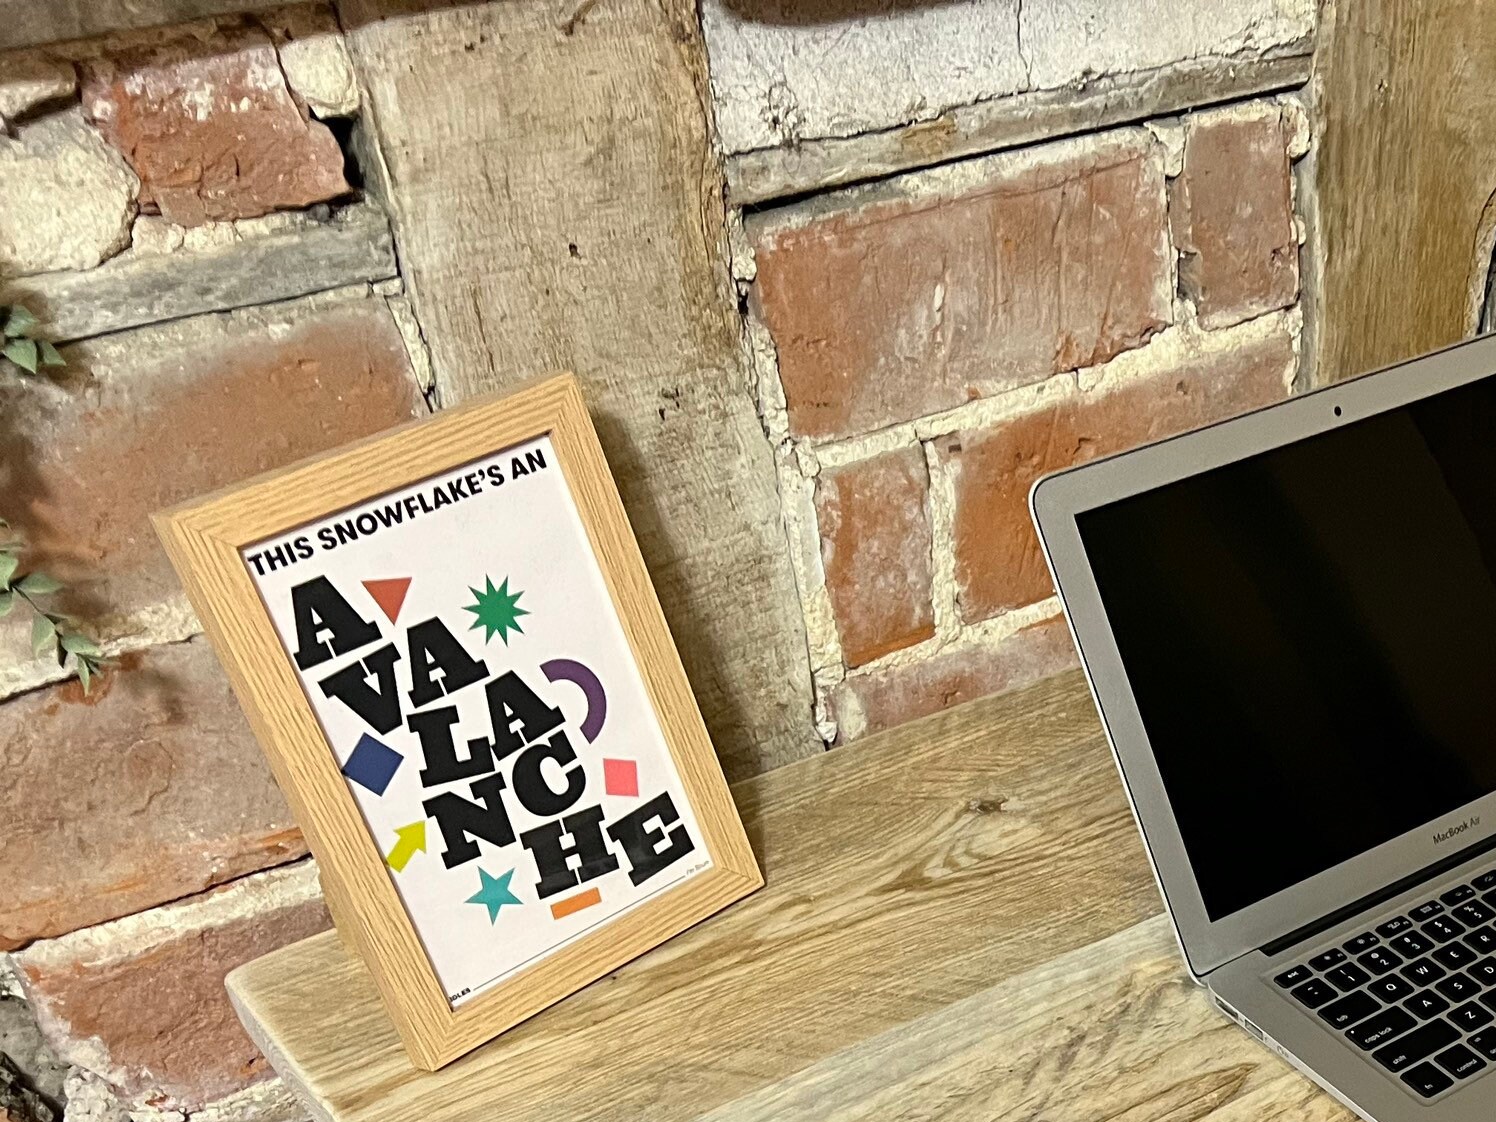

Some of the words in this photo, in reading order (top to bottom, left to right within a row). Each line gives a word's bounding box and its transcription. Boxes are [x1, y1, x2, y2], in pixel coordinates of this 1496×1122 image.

[247, 536, 314, 576] THIS
[511, 448, 547, 480] AN
[1432, 820, 1469, 845] MacBook
[1470, 816, 1480, 828] Air
[1379, 958, 1390, 966] 2
[1473, 911, 1483, 919] 5
[1385, 983, 1397, 991] Q
[1415, 965, 1429, 975] W
[1449, 950, 1460, 959] E
[1479, 935, 1491, 943] R
[1422, 999, 1433, 1008] A
[1453, 982, 1463, 990] S
[1483, 966, 1495, 974] D
[1464, 1010, 1476, 1020] Z
